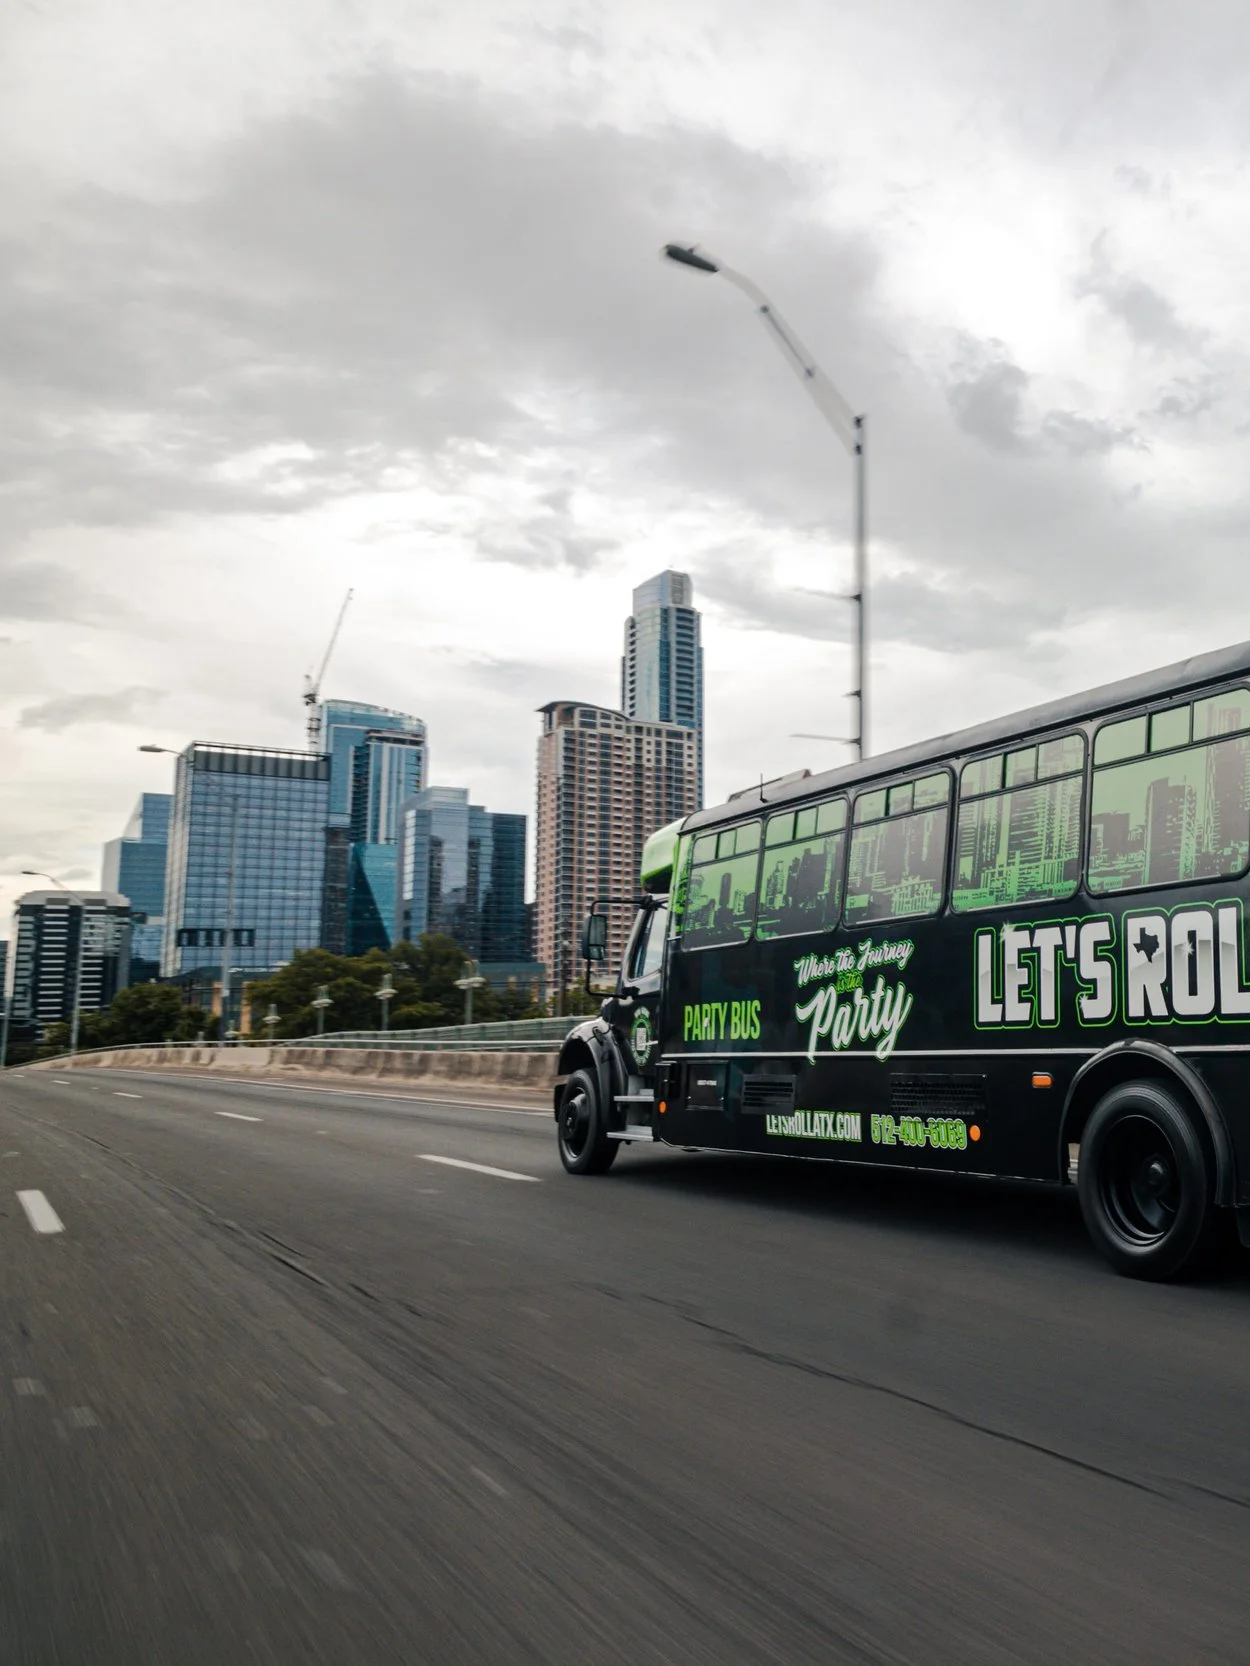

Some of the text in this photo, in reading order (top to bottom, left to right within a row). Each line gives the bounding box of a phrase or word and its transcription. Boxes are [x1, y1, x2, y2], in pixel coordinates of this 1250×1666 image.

[794, 938, 914, 987] Where the Journey
[845, 970, 863, 992] the
[976, 915, 1114, 1026] LET'S
[683, 1001, 728, 1042] PARTY
[730, 999, 761, 1040] BUS
[796, 975, 913, 1065] Party
[766, 1110, 968, 1150] LETSROLLATX.COM 512-400-6069
